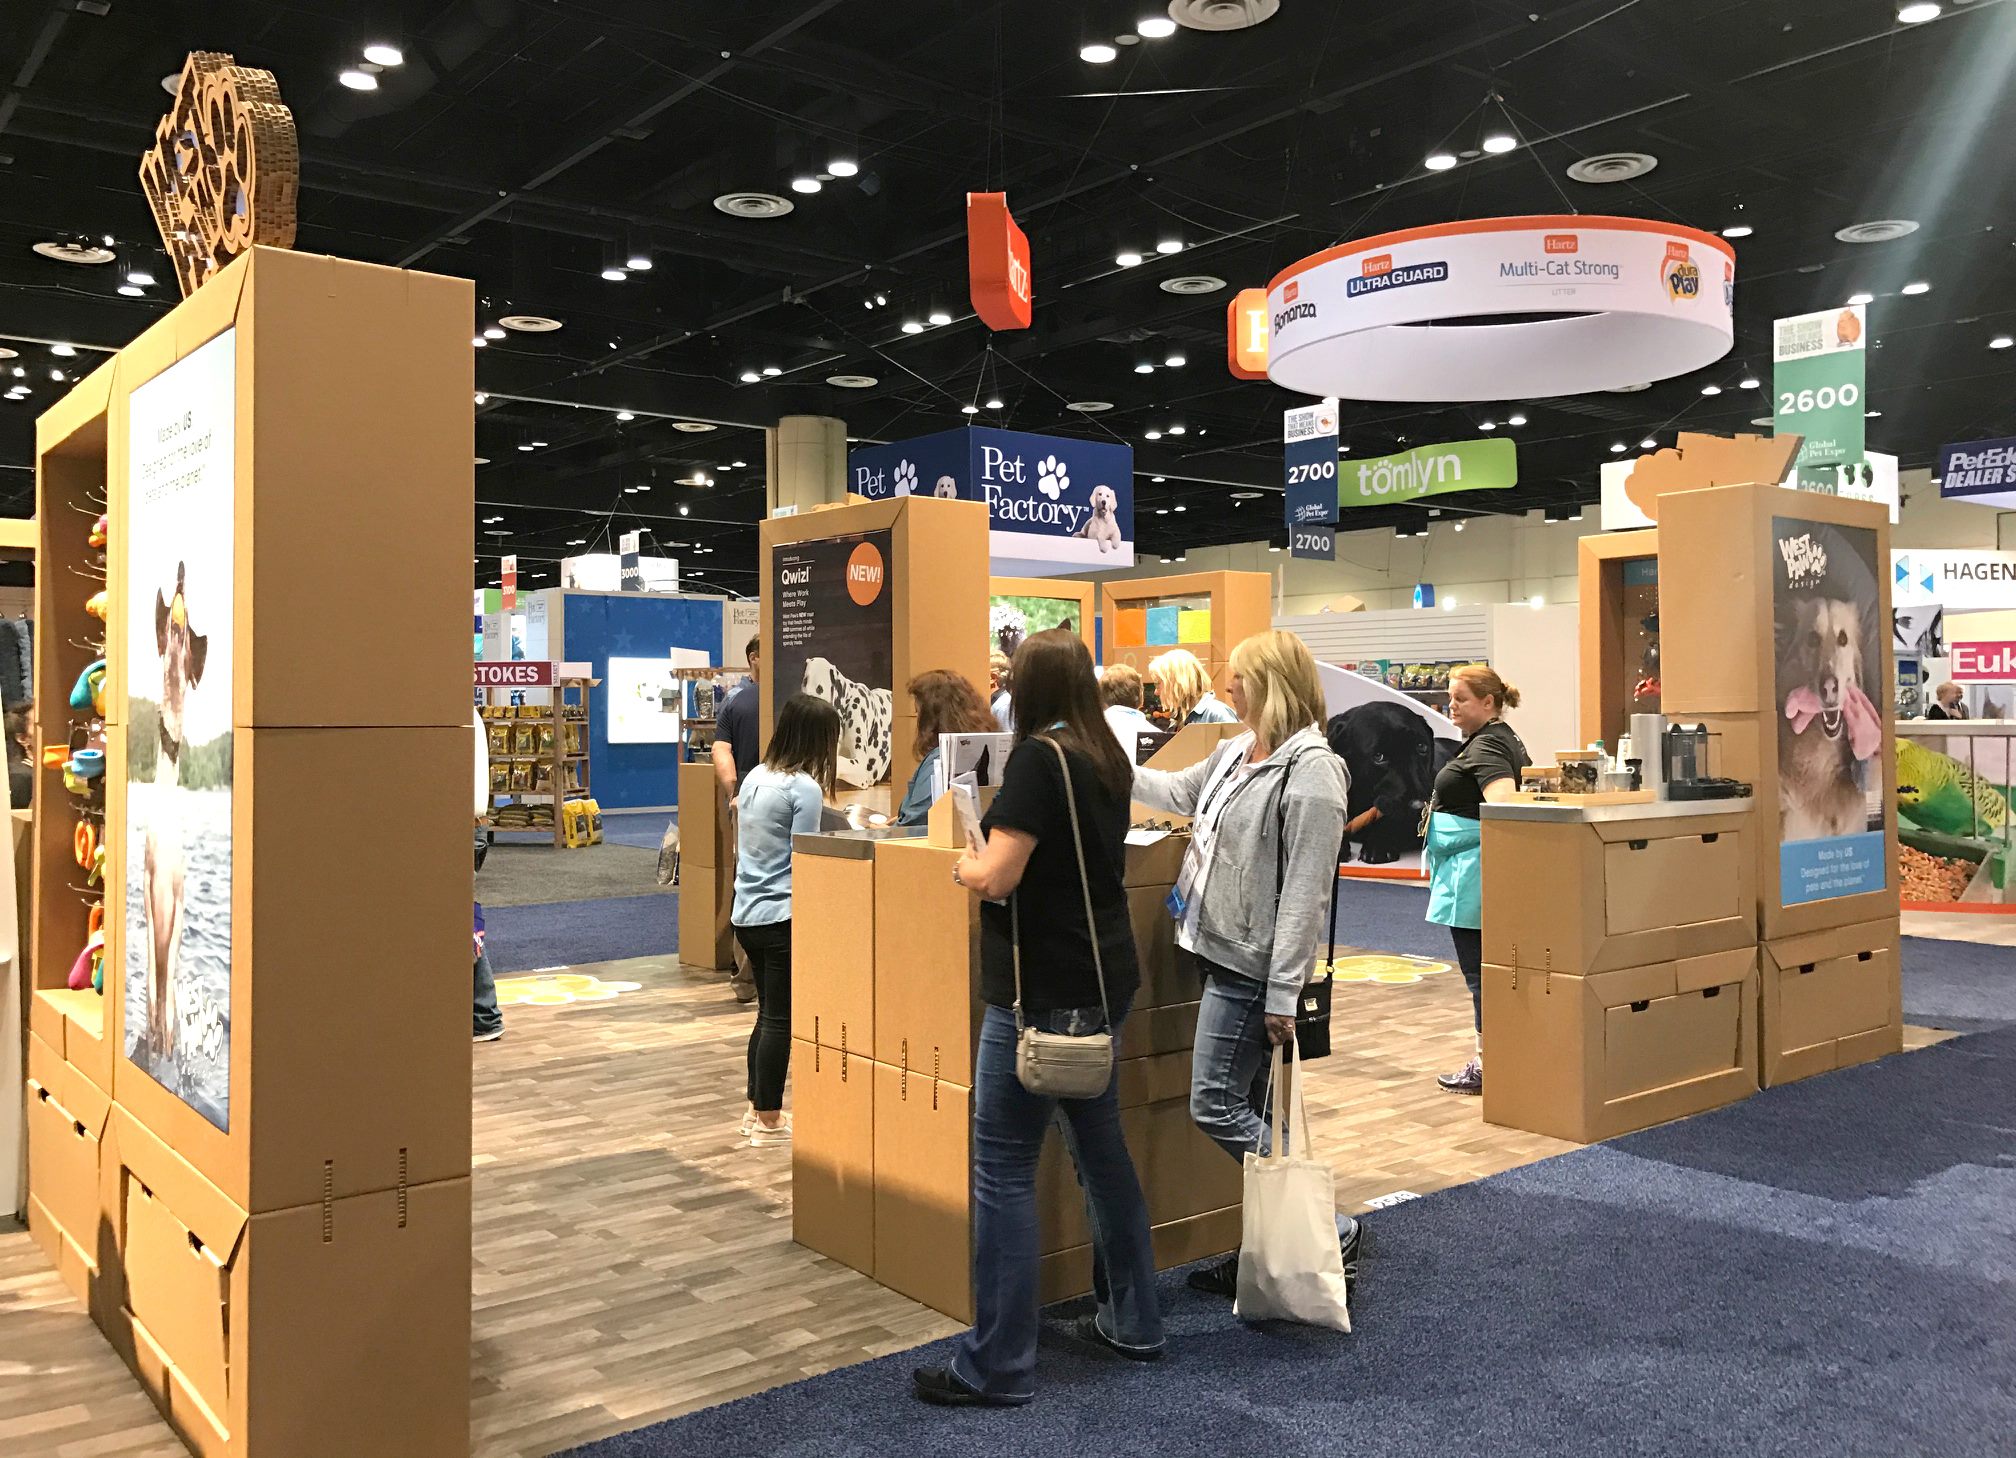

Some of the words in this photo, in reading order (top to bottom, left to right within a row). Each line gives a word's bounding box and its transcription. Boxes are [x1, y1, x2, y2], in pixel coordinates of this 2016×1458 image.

[1364, 260, 1390, 274] Hartz
[1499, 260, 1571, 277] Multi-Cat
[1574, 260, 1619, 280] Strong
[1670, 273, 1699, 296] Play
[1274, 302, 1317, 337] Bonanza
[1778, 338, 1824, 356] BUSINESS
[1779, 383, 1858, 415] 2600
[1288, 426, 1314, 438] BUSINESS
[980, 445, 1026, 484] Pet
[1288, 461, 1334, 484] 2700
[856, 466, 887, 496] Pet
[1944, 467, 2004, 489] DEALER
[981, 484, 1083, 532] Factory
[1295, 533, 1330, 551] 2700
[1778, 533, 1811, 561] WEST
[621, 566, 639, 579] 3000
[781, 566, 809, 585] Qwizl
[849, 564, 881, 584] NEW!
[1786, 554, 1811, 580] PAW
[1943, 562, 2016, 581] HAGEN
[1844, 846, 1854, 857] US
